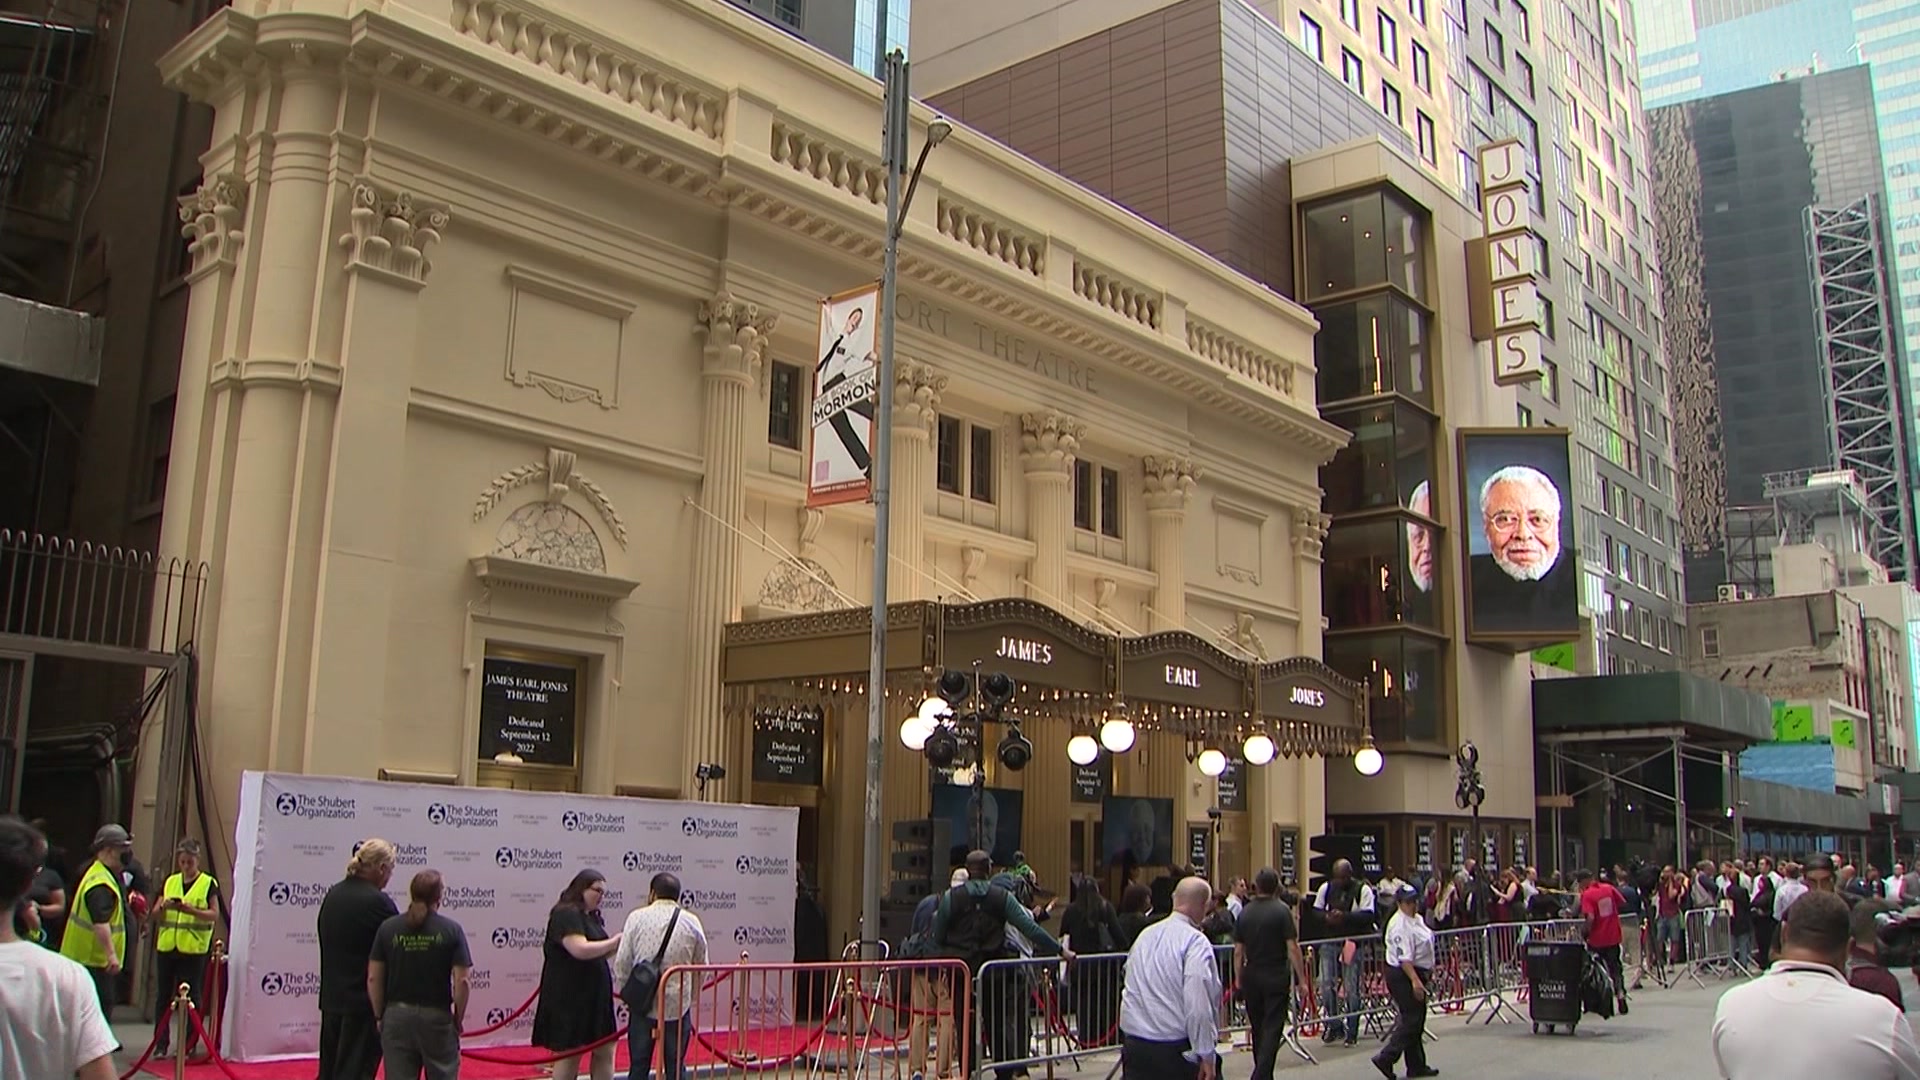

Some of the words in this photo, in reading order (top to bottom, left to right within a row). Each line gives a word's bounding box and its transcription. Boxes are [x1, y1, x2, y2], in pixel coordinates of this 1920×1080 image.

[1490, 146, 1527, 371] JONES
[896, 292, 952, 337] ORT
[973, 321, 1097, 394] THEATRE
[830, 377, 857, 397] BOOK
[814, 379, 875, 423] MORMON
[996, 636, 1052, 665] JAMES
[1165, 664, 1201, 688] EARL
[485, 673, 515, 687] JAMES
[516, 677, 540, 690] EARL
[539, 680, 568, 693] JONES
[505, 689, 549, 703] THEATRE
[1289, 686, 1324, 708] JONES
[508, 715, 545, 728] Dedicated
[500, 728, 541, 741] September
[542, 732, 551, 742] 12
[516, 742, 535, 753] 2022
[766, 752, 797, 764] September
[297, 794, 316, 806] The
[319, 795, 356, 809] Shubert
[296, 806, 356, 820] Organization
[446, 804, 463, 816] The
[465, 805, 498, 817] Shubert
[445, 816, 498, 828] Organization
[578, 812, 594, 823] The
[595, 812, 625, 824] Shubert
[697, 818, 710, 828] The
[711, 819, 738, 829] Shubert
[578, 822, 625, 834] Organization
[696, 828, 738, 839] Organization
[394, 843, 427, 855] hubert
[512, 848, 529, 860] The
[530, 848, 562, 860] Shubert
[638, 852, 653, 863] The
[653, 852, 682, 864] Shubert
[750, 856, 762, 866] The
[763, 857, 788, 867] Shubert
[512, 859, 562, 870] Organization
[637, 862, 682, 873] Organization
[749, 865, 788, 876] Organization
[291, 883, 310, 895] The
[444, 886, 460, 897] The
[461, 887, 495, 898] Shubert
[694, 890, 709, 900] The
[709, 890, 737, 900] Shubert
[442, 898, 495, 910] Organization
[694, 900, 737, 910] Organization
[510, 927, 526, 938] The
[748, 927, 761, 936] The
[761, 927, 786, 937] Shubert
[747, 936, 787, 947] Organization
[284, 972, 303, 984] The
[1538, 983, 1567, 993] SQUARE
